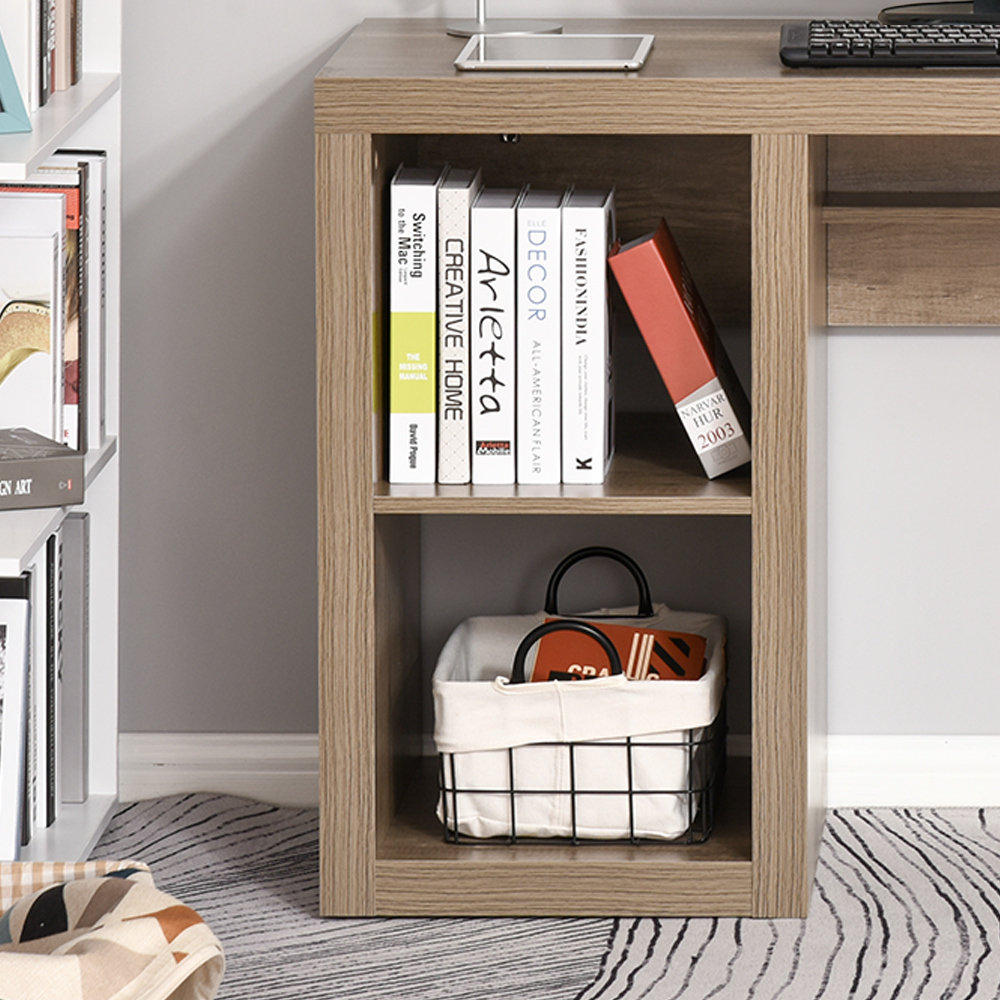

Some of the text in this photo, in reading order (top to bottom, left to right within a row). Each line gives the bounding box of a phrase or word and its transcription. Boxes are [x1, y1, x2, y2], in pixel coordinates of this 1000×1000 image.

[397, 208, 409, 265] to the Mac
[411, 212, 428, 279] Switching
[526, 229, 548, 321] DECOR
[444, 237, 464, 421] CREATIVE HOME
[478, 248, 511, 415] Arletta
[680, 393, 726, 419] NARVAR
[692, 408, 724, 428] HUR
[408, 423, 418, 447] David
[697, 422, 736, 449] 2003
[14, 478, 32, 495] ART
